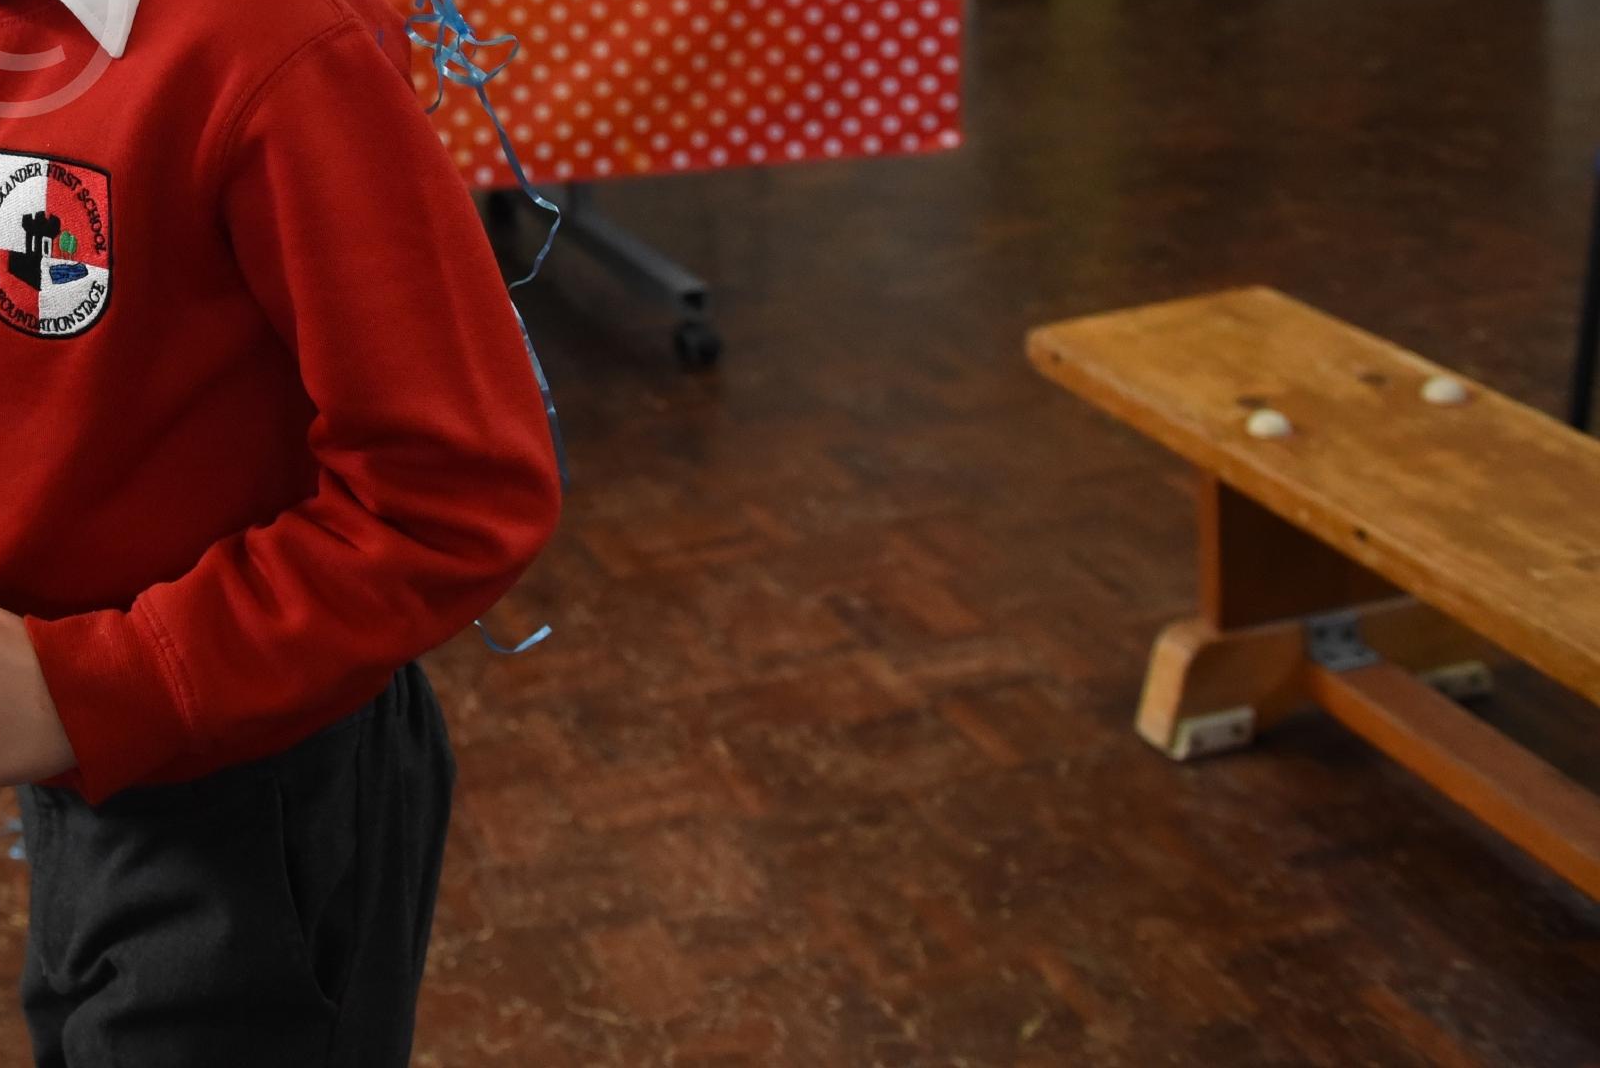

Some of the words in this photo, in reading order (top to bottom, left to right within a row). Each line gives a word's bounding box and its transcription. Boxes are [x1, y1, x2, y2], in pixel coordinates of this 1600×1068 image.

[46, 163, 83, 191] FIRST
[78, 188, 107, 255] SCHOOL
[75, 280, 106, 324] STAGE
